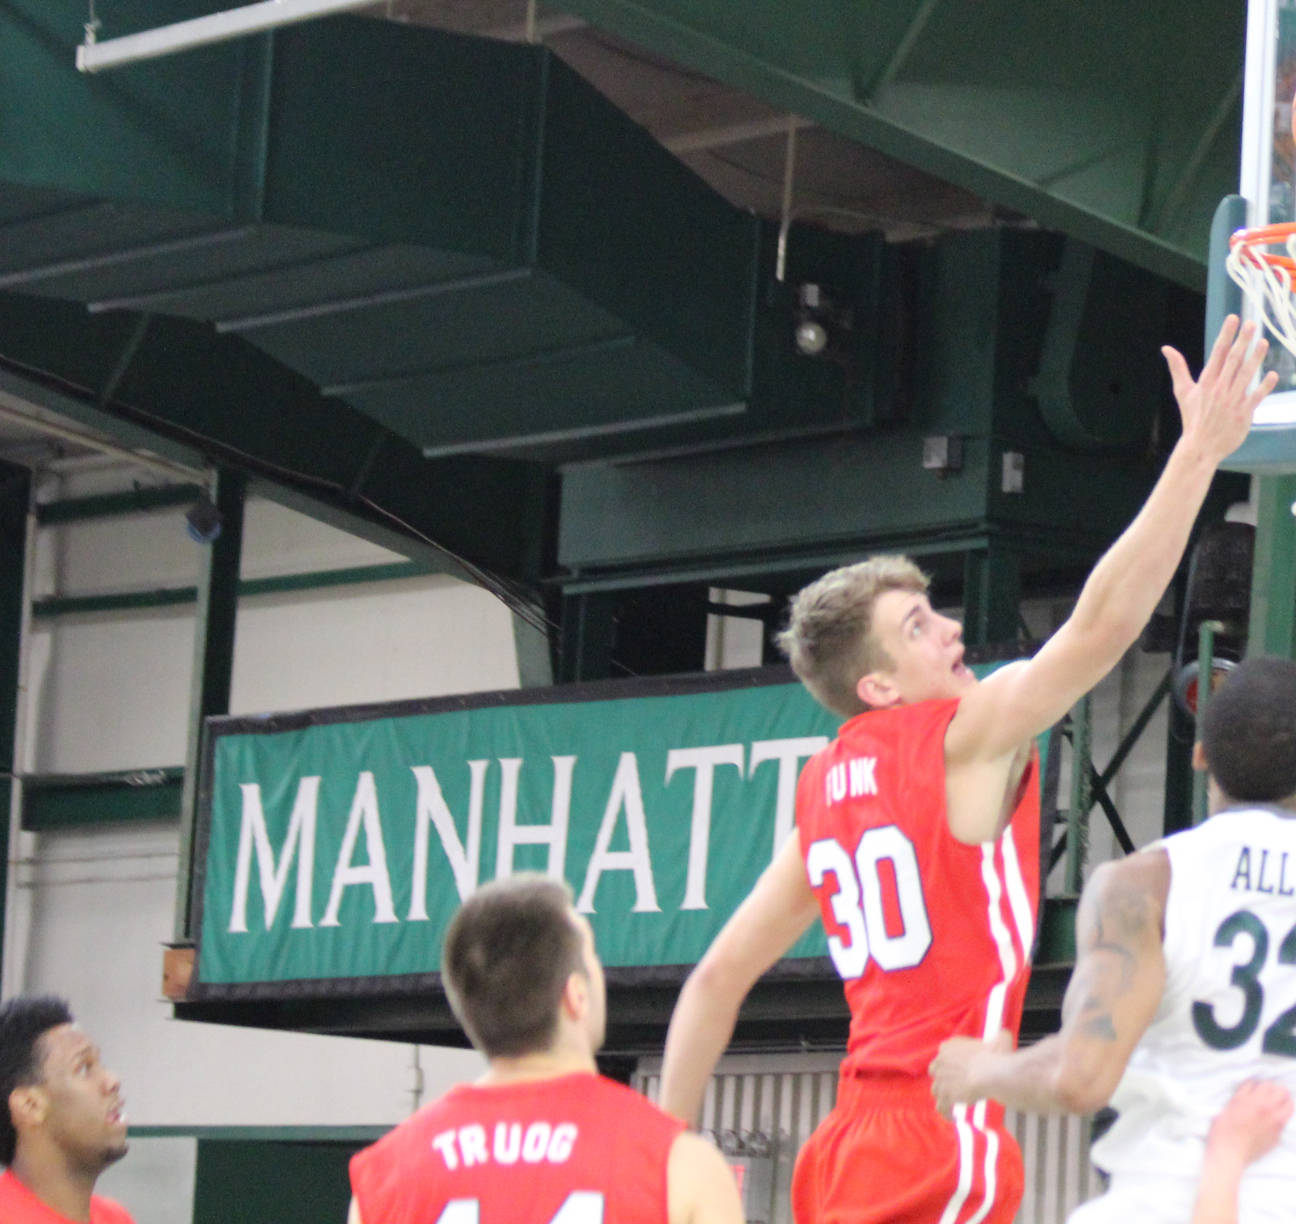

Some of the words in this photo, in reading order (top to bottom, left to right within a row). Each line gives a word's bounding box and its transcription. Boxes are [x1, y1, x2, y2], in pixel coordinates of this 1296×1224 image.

[227, 736, 829, 934] MANHATT
[806, 823, 934, 980] 30
[431, 1120, 578, 1171] TRUOG
